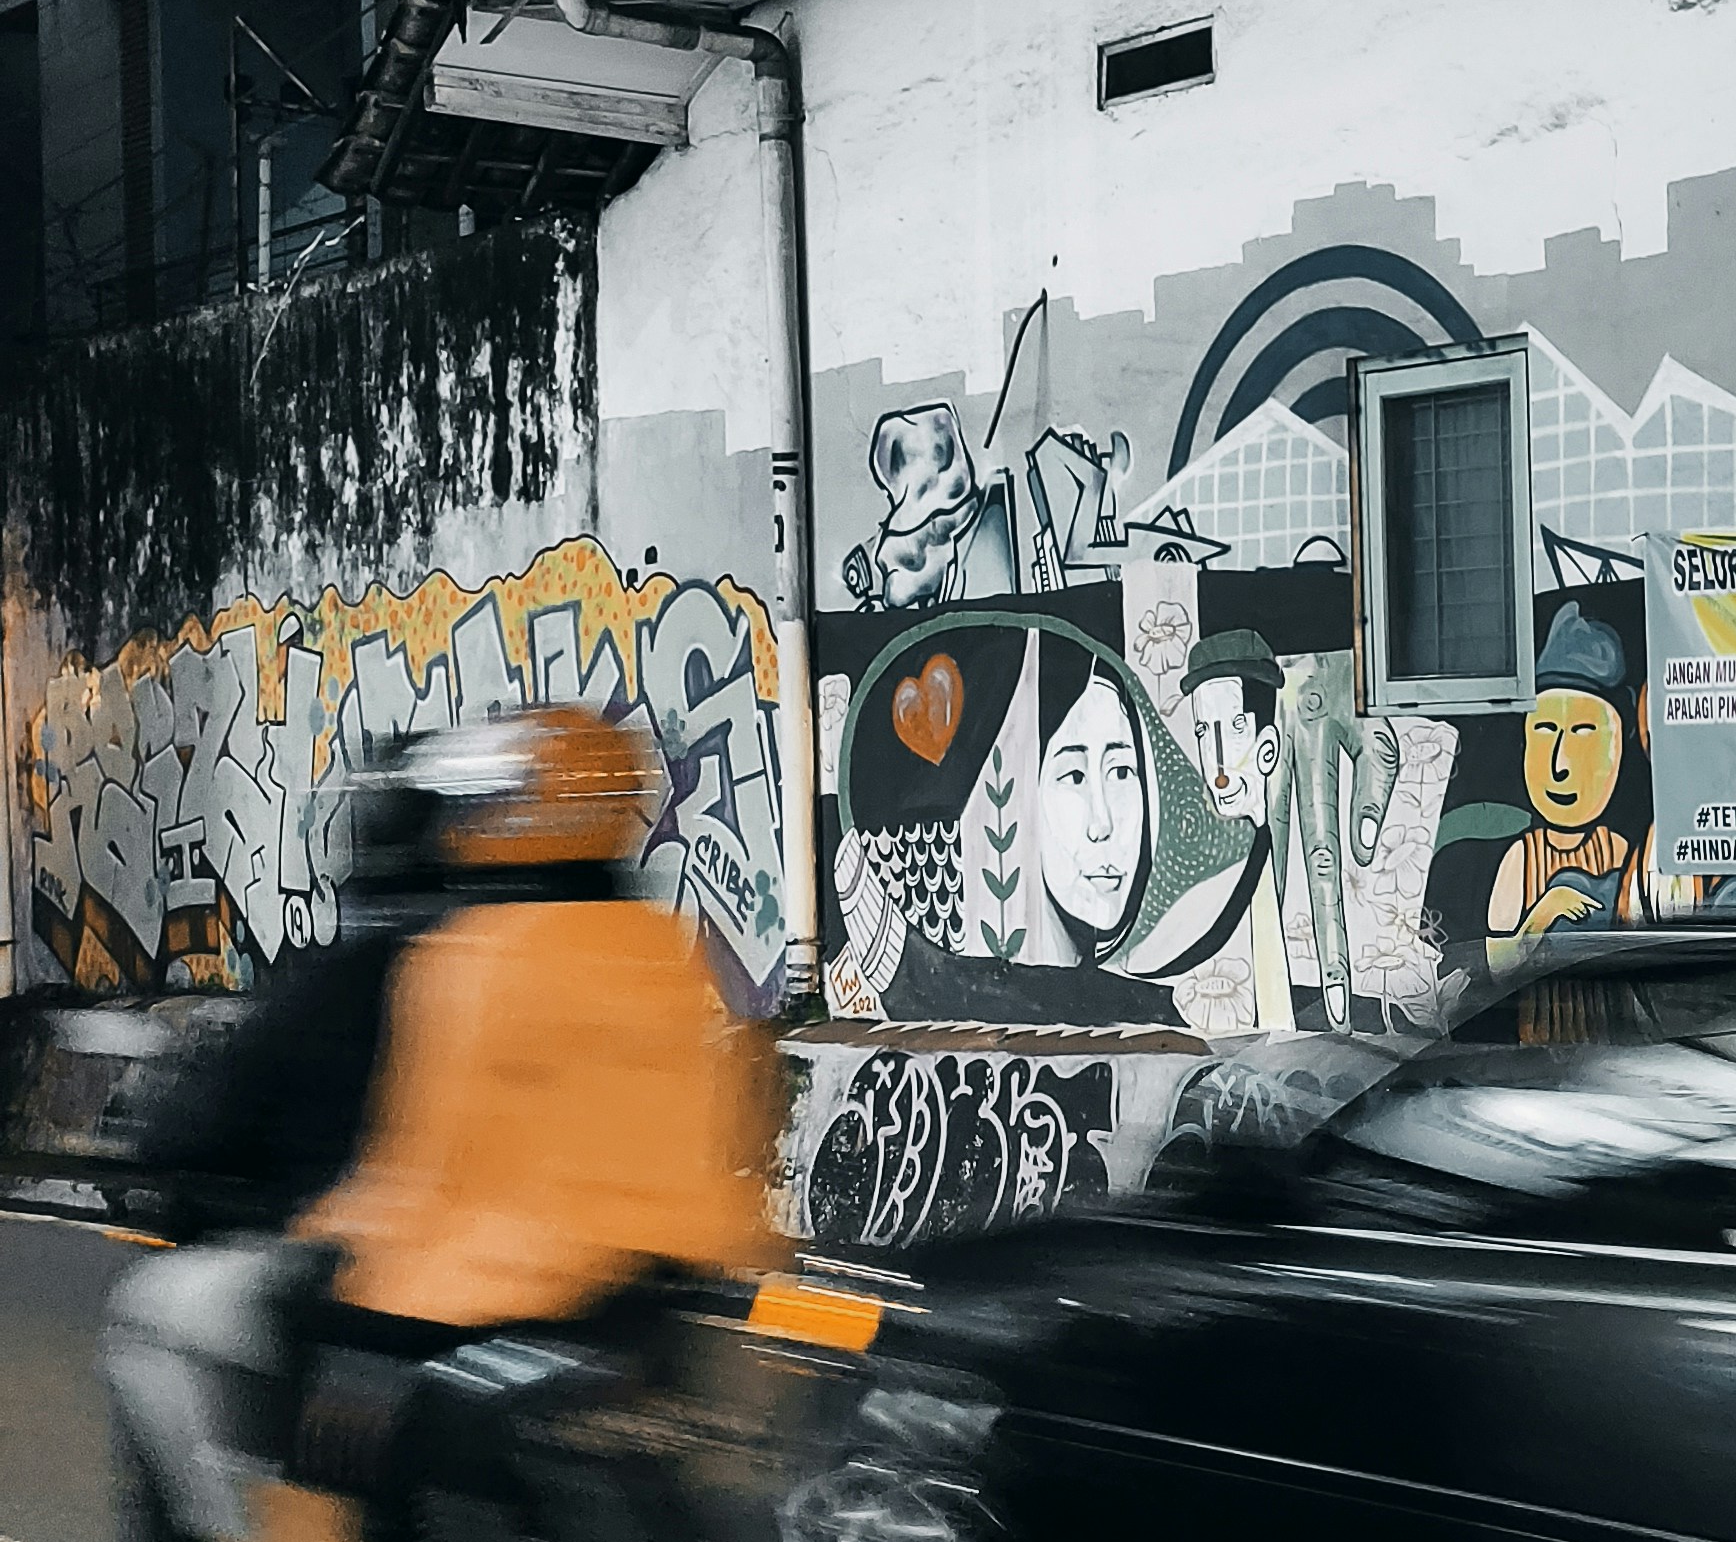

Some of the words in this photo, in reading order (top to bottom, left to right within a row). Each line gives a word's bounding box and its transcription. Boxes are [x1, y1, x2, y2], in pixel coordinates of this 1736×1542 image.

[1665, 661, 1711, 686] JANGAN
[1666, 697, 1714, 721] APALAGI
[852, 995, 877, 1015] 2021
